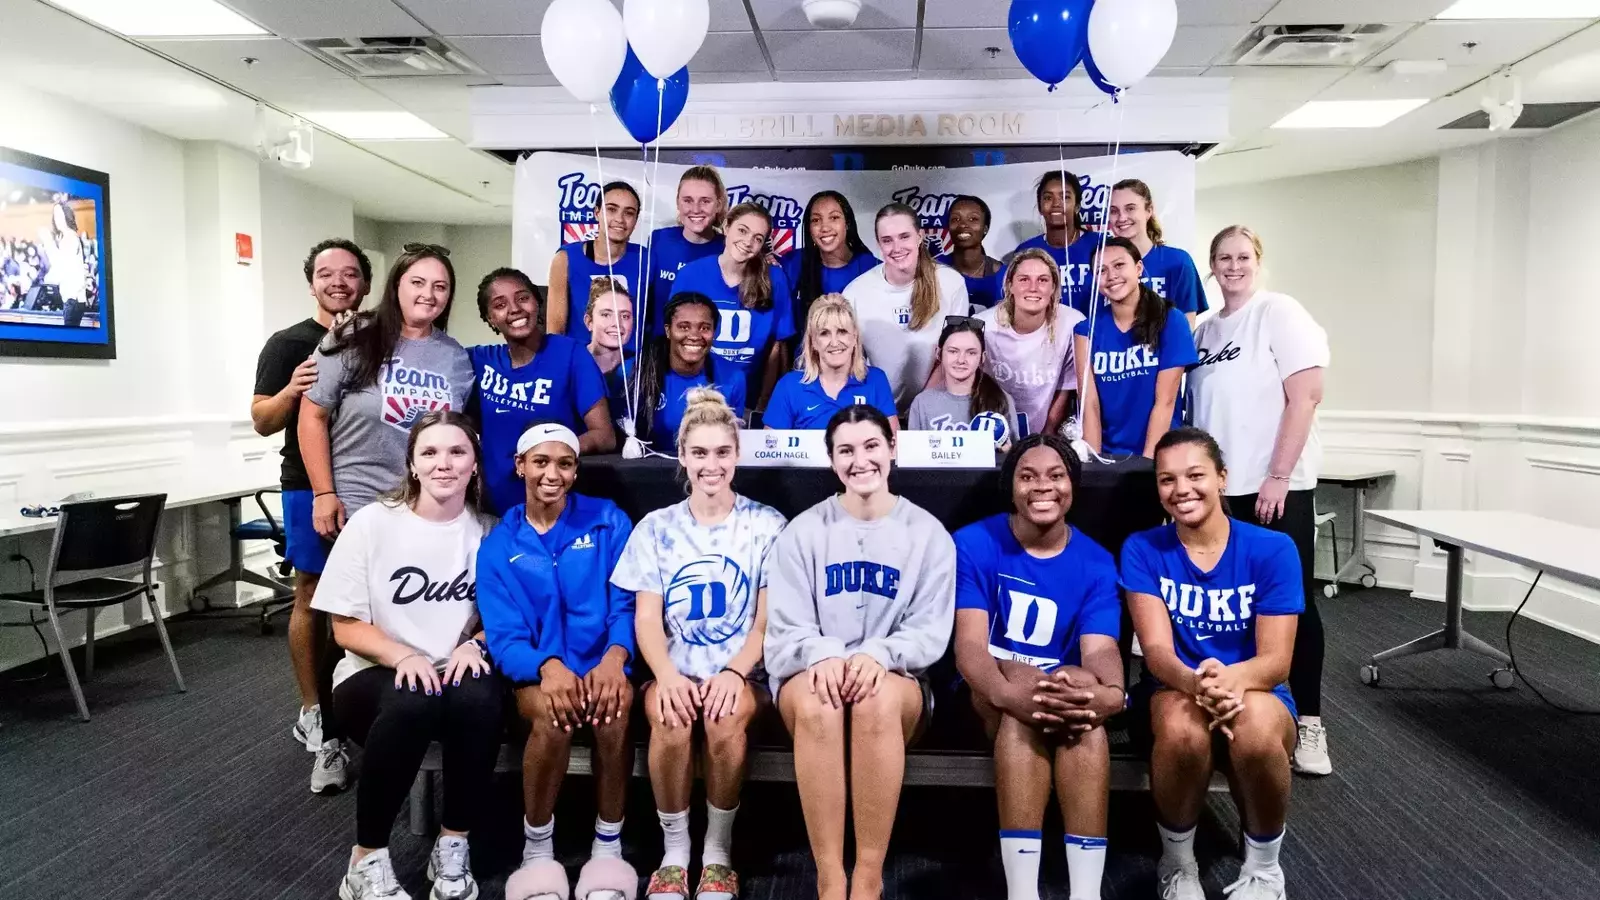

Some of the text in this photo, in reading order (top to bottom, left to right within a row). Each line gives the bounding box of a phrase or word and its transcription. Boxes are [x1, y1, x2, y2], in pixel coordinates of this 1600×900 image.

[740, 115, 823, 138] BRILL
[833, 113, 927, 137] MEDIA
[937, 112, 1025, 137] ROOM
[560, 174, 599, 209] Tea
[561, 210, 594, 221] IMP
[1093, 344, 1159, 375] DUKE
[382, 357, 450, 392] Team
[480, 364, 553, 405] DUKE
[1101, 369, 1150, 383] VOLLEYBALL
[384, 386, 451, 402] IMPACT
[483, 392, 535, 412] VOLLEYBALL
[754, 450, 809, 459] COACH NAGEL
[931, 451, 962, 460] BAILEY
[825, 560, 901, 601] DUKE
[686, 581, 727, 621] D
[1159, 575, 1256, 622] DUKE
[1003, 589, 1059, 647] D
[1171, 614, 1248, 632] OLEYBALL
